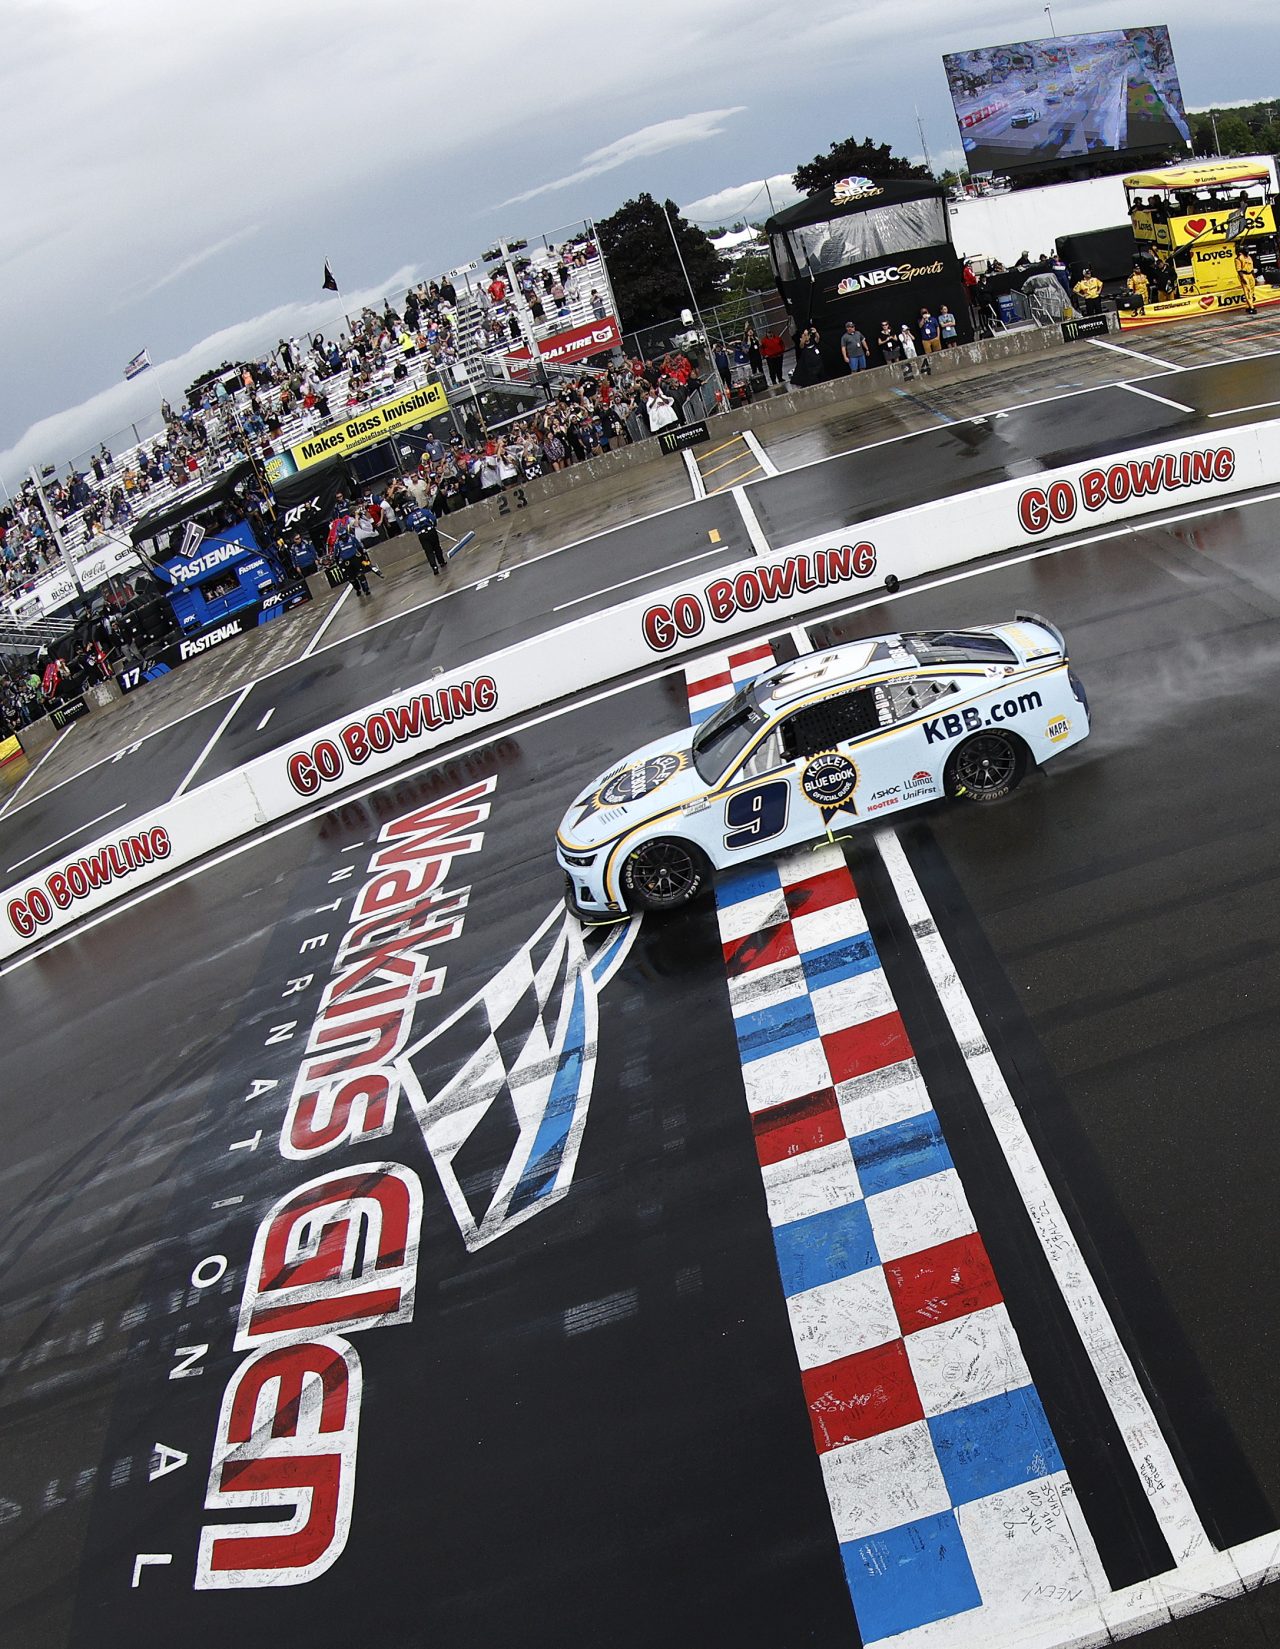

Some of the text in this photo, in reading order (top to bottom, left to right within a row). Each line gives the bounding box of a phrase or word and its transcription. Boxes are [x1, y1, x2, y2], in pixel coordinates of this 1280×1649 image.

[830, 187, 884, 206] Sports
[835, 184, 877, 199] NBC
[859, 261, 943, 288] NBC Sports
[1183, 286, 1194, 294] 34
[565, 336, 592, 352] TIRE
[901, 357, 931, 382] 24
[302, 387, 441, 460] Makes Glass Invisible!
[346, 421, 402, 450] InvisibleGlass.com
[677, 427, 704, 440] MONSTER
[497, 488, 527, 515] 23
[1018, 446, 1235, 535] GO BOWLING
[181, 521, 206, 558] 17
[169, 538, 245, 586] FASTENAL
[238, 559, 265, 575] FASTENAL
[51, 582, 75, 600] BUSCH
[263, 593, 282, 609] RFK
[642, 540, 877, 651] GO BOWLING
[184, 614, 196, 624] RFK
[180, 620, 242, 661] FASTENAL
[123, 667, 140, 689] 17
[922, 690, 1043, 745] KBB.com
[1048, 721, 1068, 739] NAPA
[287, 676, 498, 796] GO BOWLING
[806, 756, 848, 777] KELLEY
[804, 768, 855, 792] BLUE BOOK
[812, 781, 852, 801] OFFICIAL GUIDE
[867, 798, 898, 812] HOOTERS
[903, 787, 936, 801] UniFirst
[723, 778, 791, 852] 9
[7, 826, 172, 938] GO BOWLING
[684, 874, 701, 898] EAGLE
[194, 774, 499, 1591] Watkins Glen
[131, 842, 366, 1588] INTERNATIONAL
[1027, 1490, 1057, 1533] THE CUP
[1040, 1481, 1061, 1517] CHASE
[1020, 1506, 1042, 1535] TAKE
